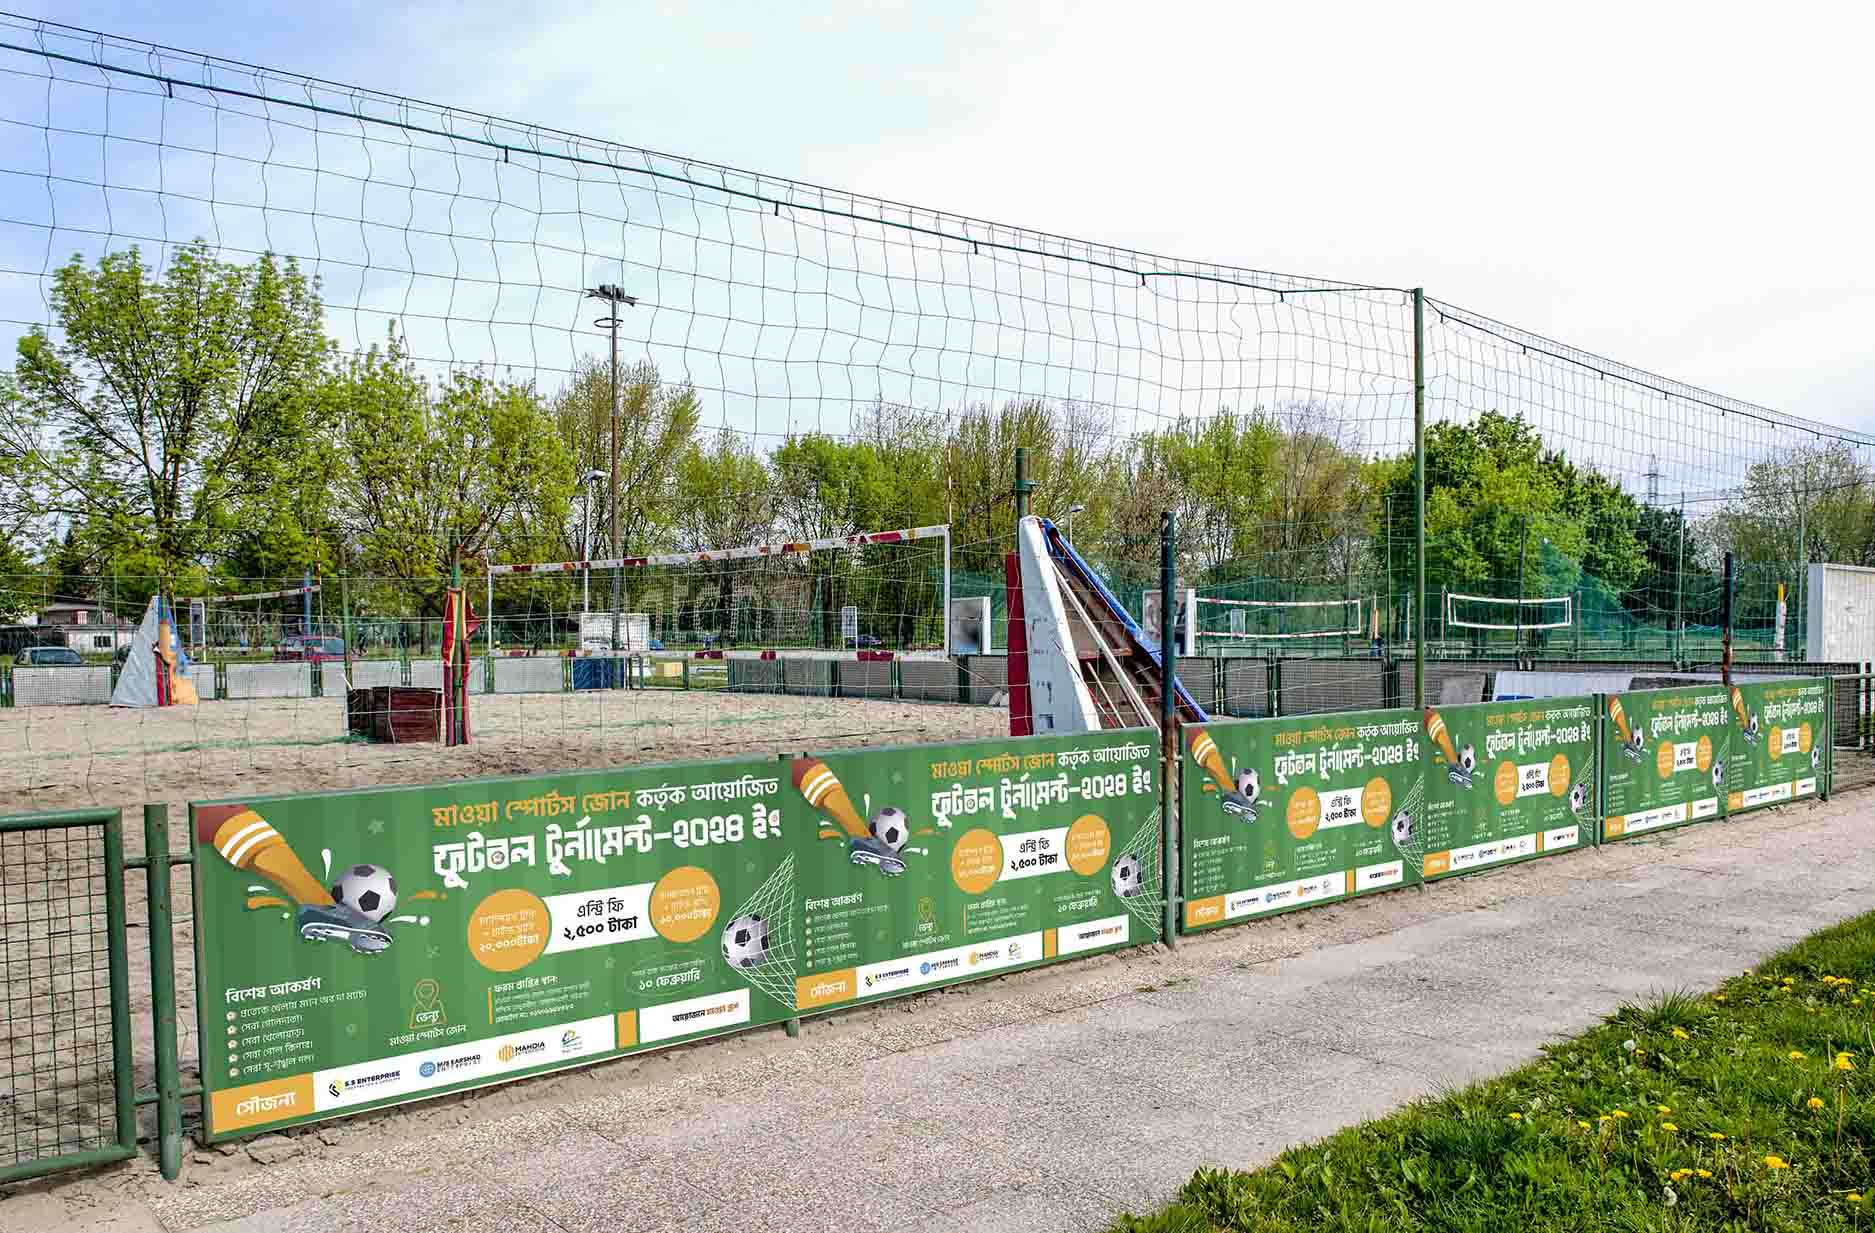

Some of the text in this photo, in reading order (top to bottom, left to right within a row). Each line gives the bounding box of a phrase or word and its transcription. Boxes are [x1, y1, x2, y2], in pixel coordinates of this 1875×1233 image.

[1058, 747, 1090, 770] কর্তৃক
[1093, 742, 1150, 764] আয়োজিত
[1274, 750, 1315, 785] ফুটবল
[432, 775, 779, 827] মাওয়া স্পোর্টস জোন কর্তৃক আয়োজিত
[931, 783, 994, 827] ফুটবল
[1132, 765, 1151, 793] ইং
[432, 831, 536, 889] ফুটবল
[752, 803, 781, 838] ইং
[1039, 853, 1058, 867] টাকা
[577, 897, 624, 918] এন্ট্রি ফি
[563, 916, 638, 941] ২,৫০০ টাকা
[225, 976, 321, 1003] বিশেষ আকর্ষণ
[515, 1041, 545, 1053] MAHDIA
[358, 1070, 401, 1085] ENTERPRISE
